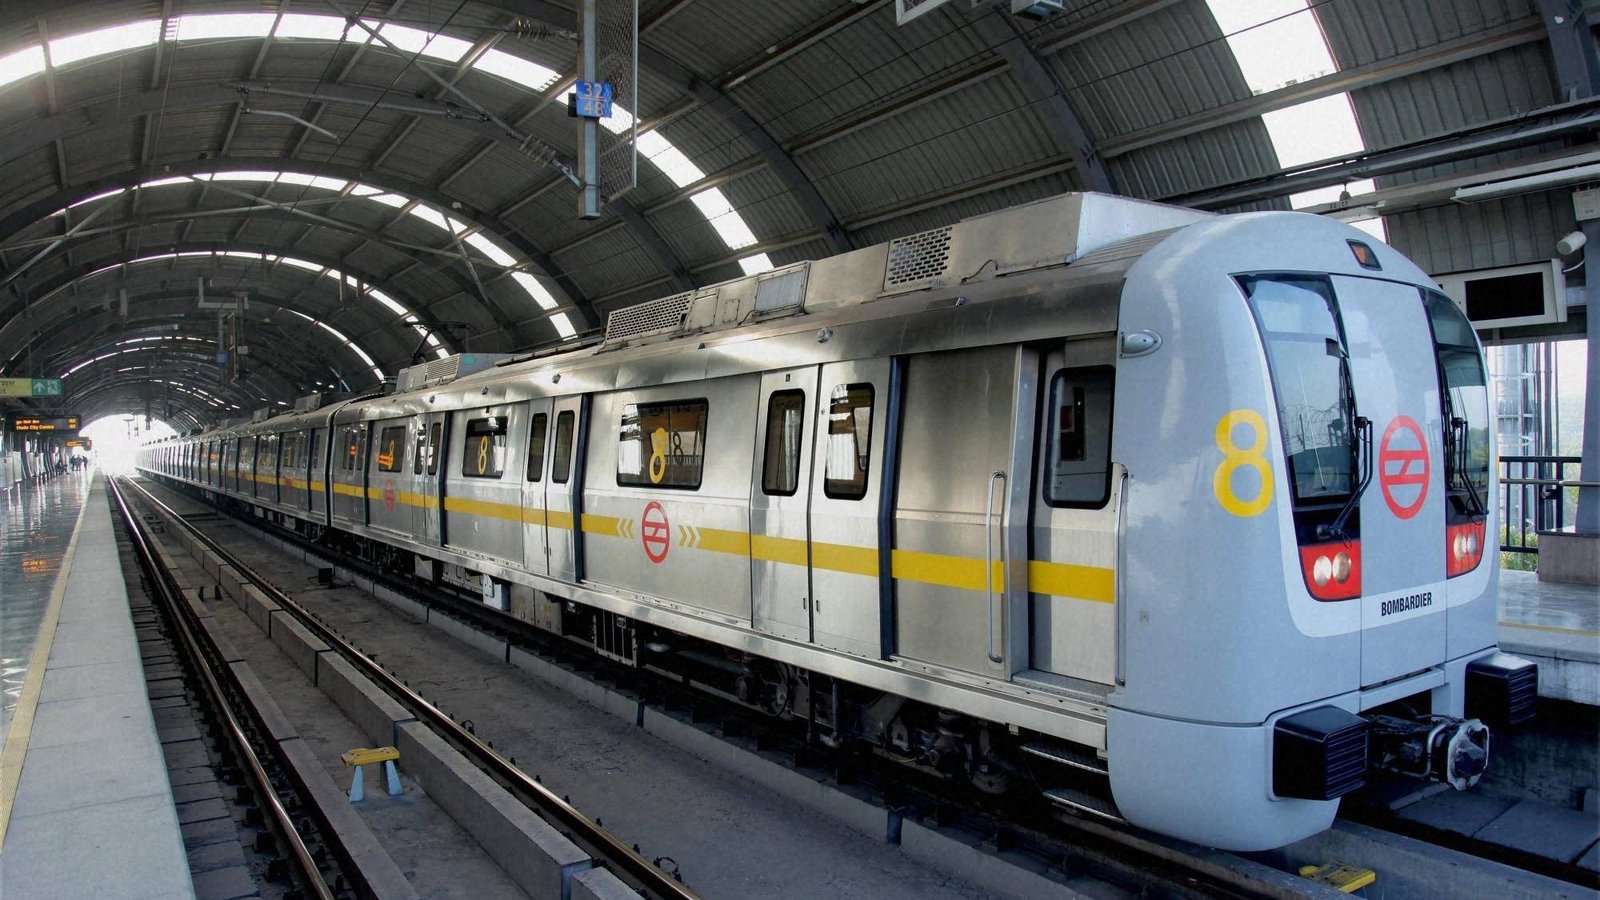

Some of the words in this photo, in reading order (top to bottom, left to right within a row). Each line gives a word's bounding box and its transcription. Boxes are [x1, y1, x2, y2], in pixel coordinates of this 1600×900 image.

[584, 82, 602, 97] 32
[584, 101, 604, 116] 48
[479, 435, 488, 475] 8
[649, 427, 668, 484] 8
[673, 431, 684, 466] 8
[1213, 408, 1274, 518] 8
[1381, 591, 1432, 617] BOMBARDIER
